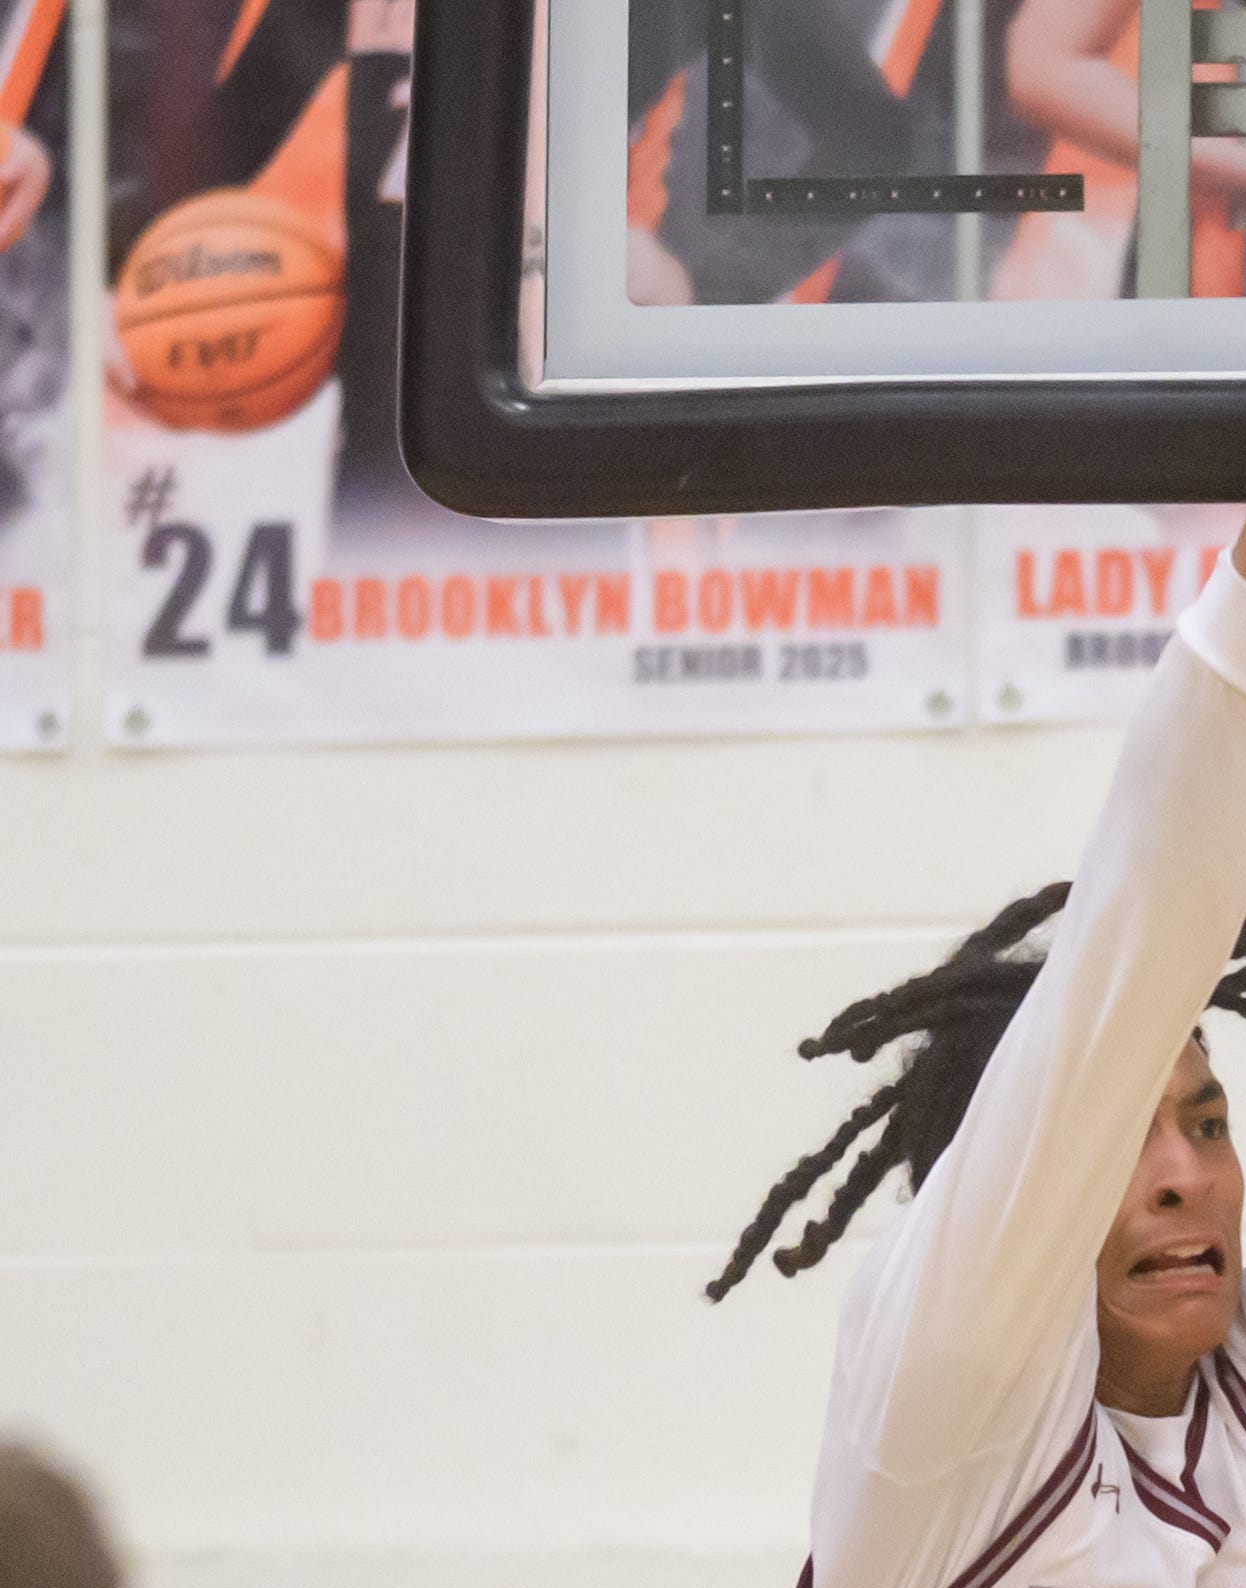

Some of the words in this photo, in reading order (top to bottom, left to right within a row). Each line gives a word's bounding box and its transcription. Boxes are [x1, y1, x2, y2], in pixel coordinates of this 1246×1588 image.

[311, 572, 631, 642] BROOKLYN
[655, 566, 940, 635] BOWMAN
[1016, 548, 1175, 618] LADY
[634, 646, 761, 684] SENIOR
[779, 642, 868, 680] 2025
